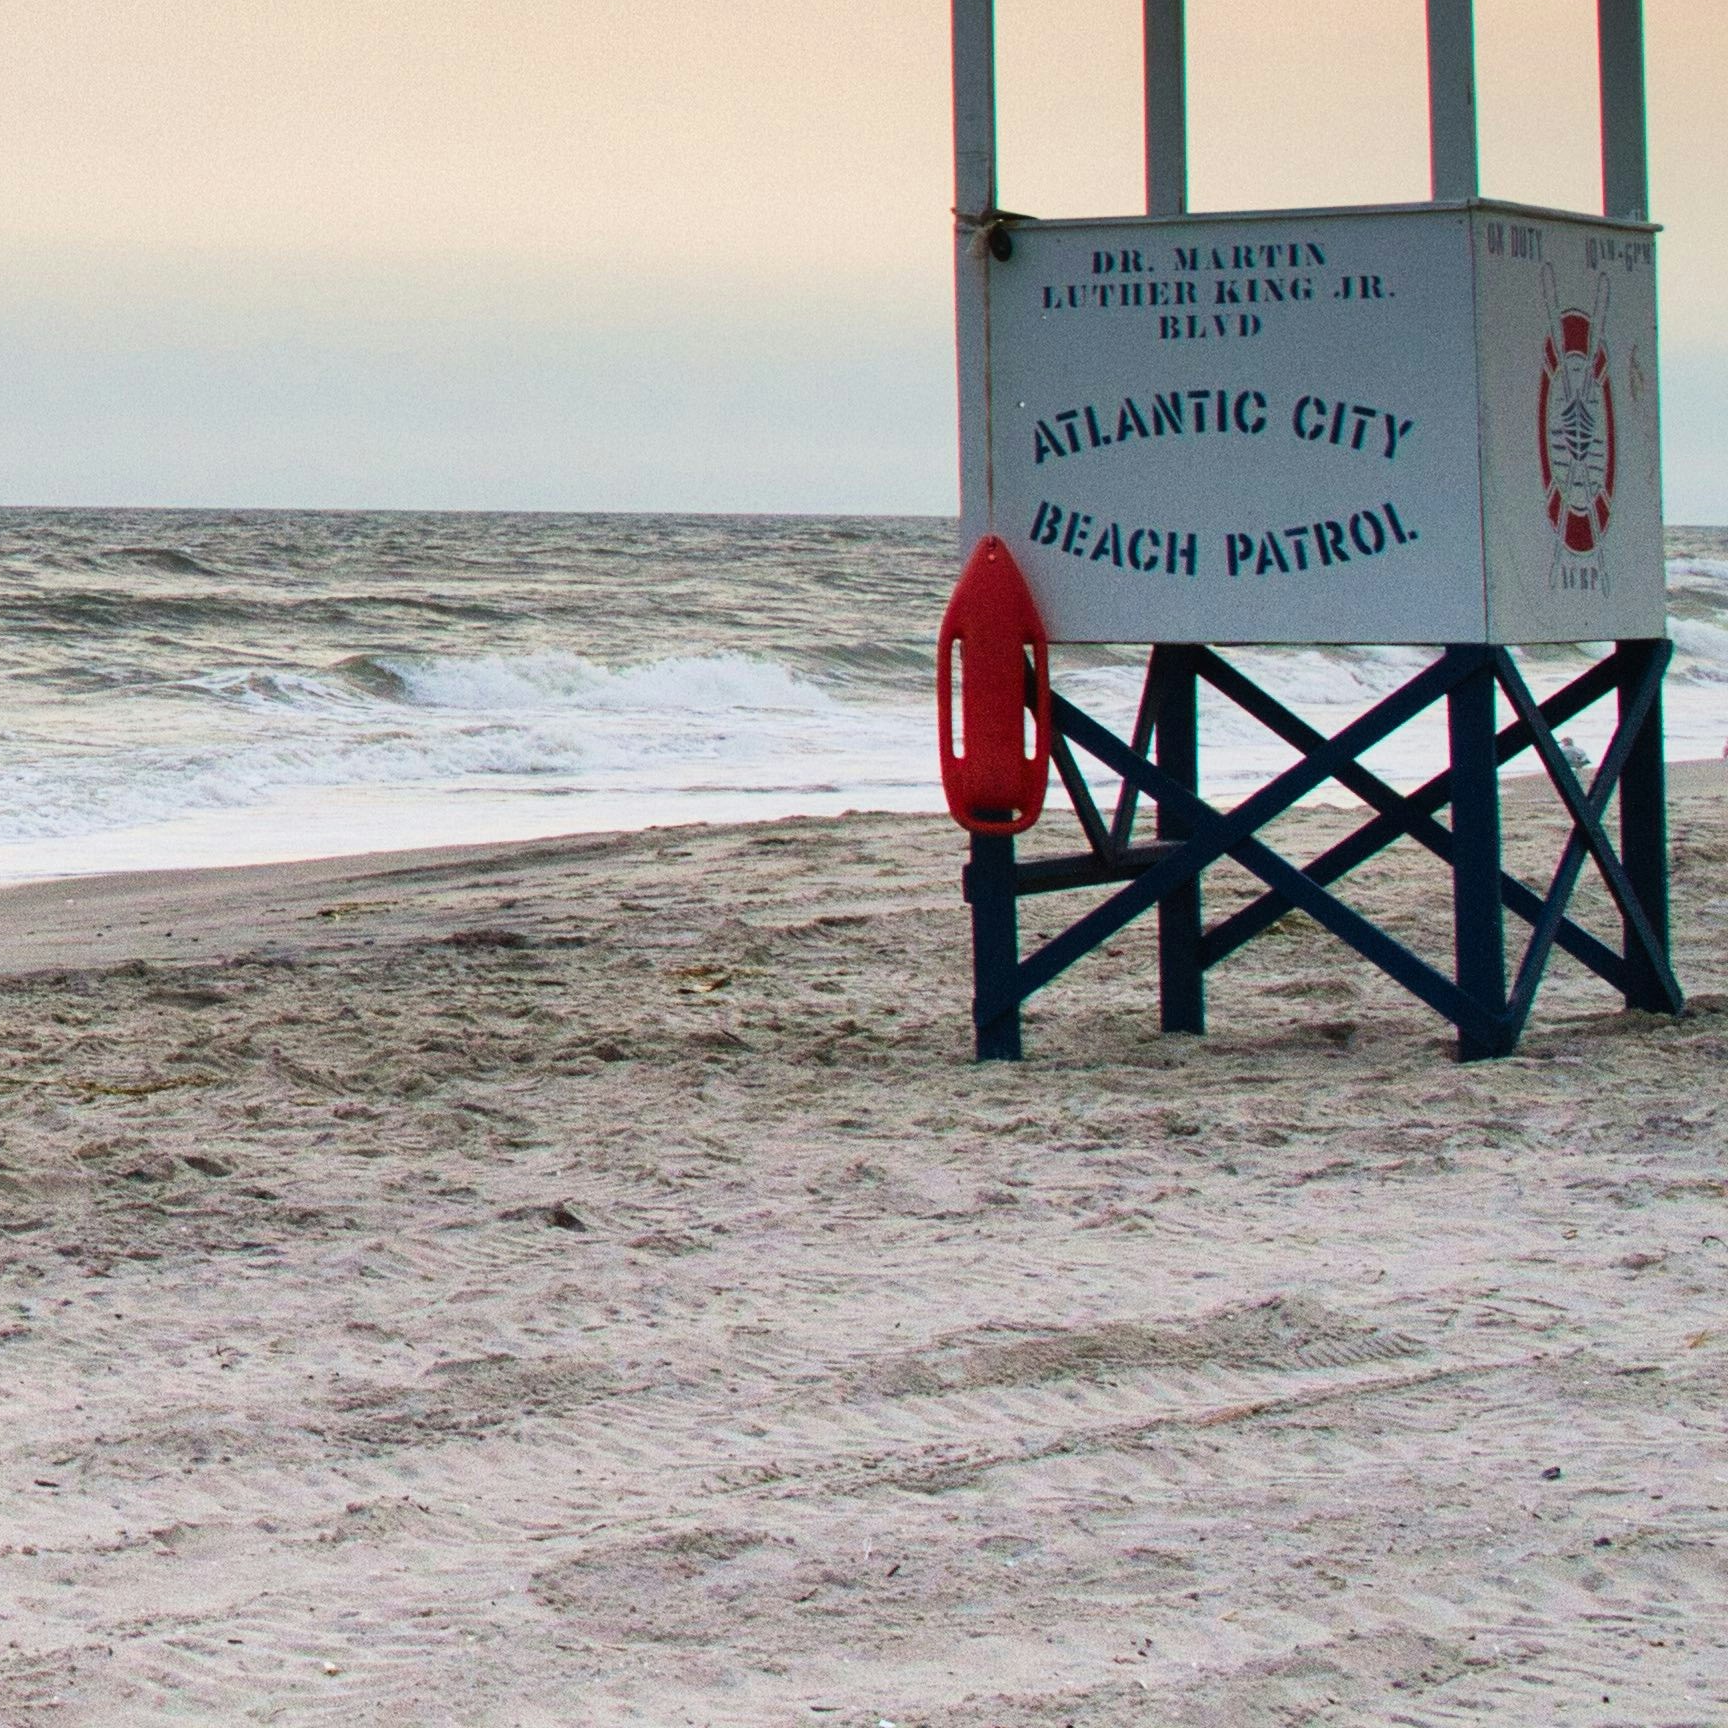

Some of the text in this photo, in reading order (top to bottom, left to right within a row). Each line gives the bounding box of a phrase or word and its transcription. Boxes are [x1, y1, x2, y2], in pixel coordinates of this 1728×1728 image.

[1091, 242, 1328, 274] DR. MARTIN
[1511, 224, 1543, 262] DUTY
[1042, 274, 1395, 310] LUTHER KING JR.
[1158, 314, 1262, 340] BLVD
[1034, 389, 1416, 465] ATLANTIC CITY
[1029, 500, 1419, 576] BEACH PATROL
